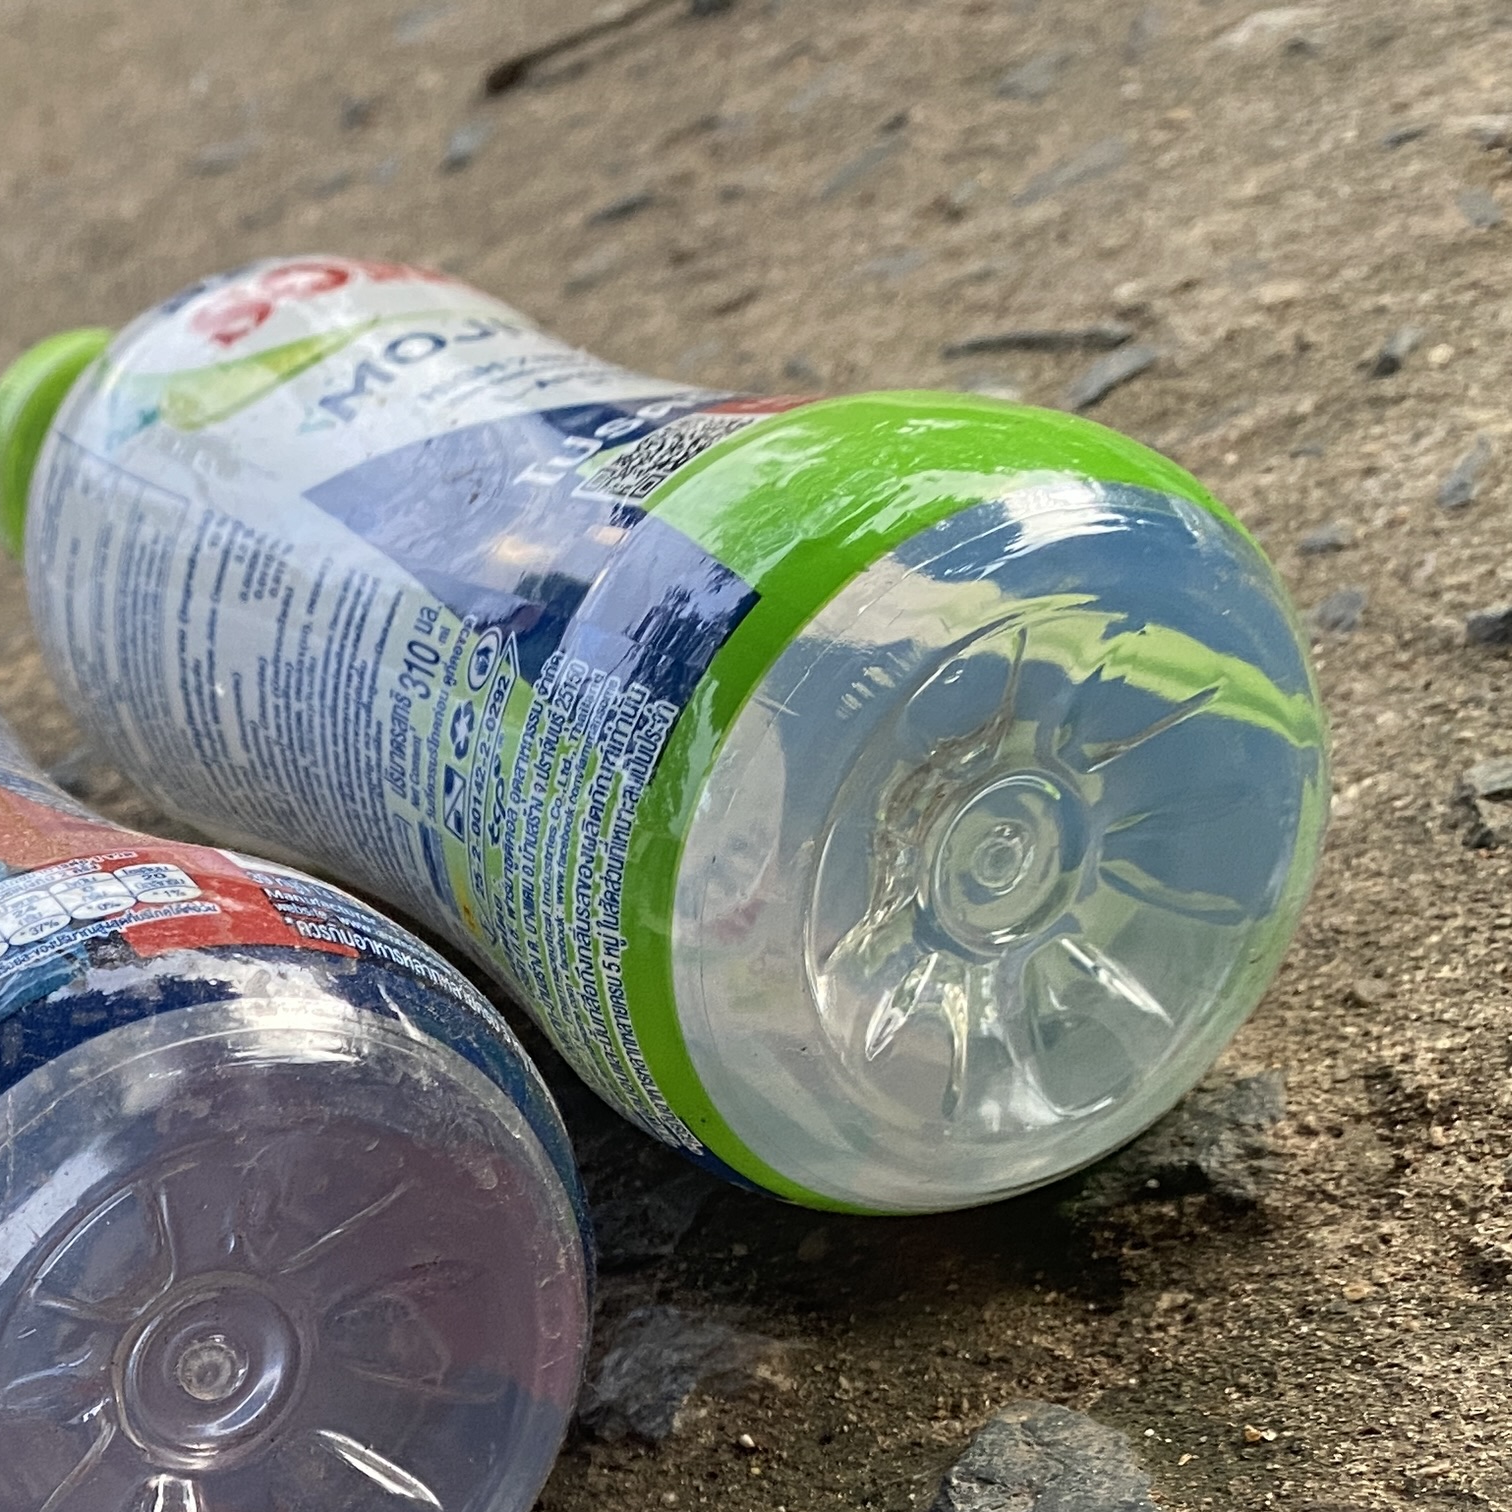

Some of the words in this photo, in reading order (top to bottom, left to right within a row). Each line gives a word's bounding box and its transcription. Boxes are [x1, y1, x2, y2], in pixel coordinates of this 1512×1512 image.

[414, 605, 441, 634] มล.
[397, 638, 441, 700] 310
[556, 662, 585, 712] 25150
[542, 824, 556, 907] Industries
[568, 672, 604, 741] Thailand
[597, 935, 625, 957] หมู่
[602, 960, 619, 972] 5
